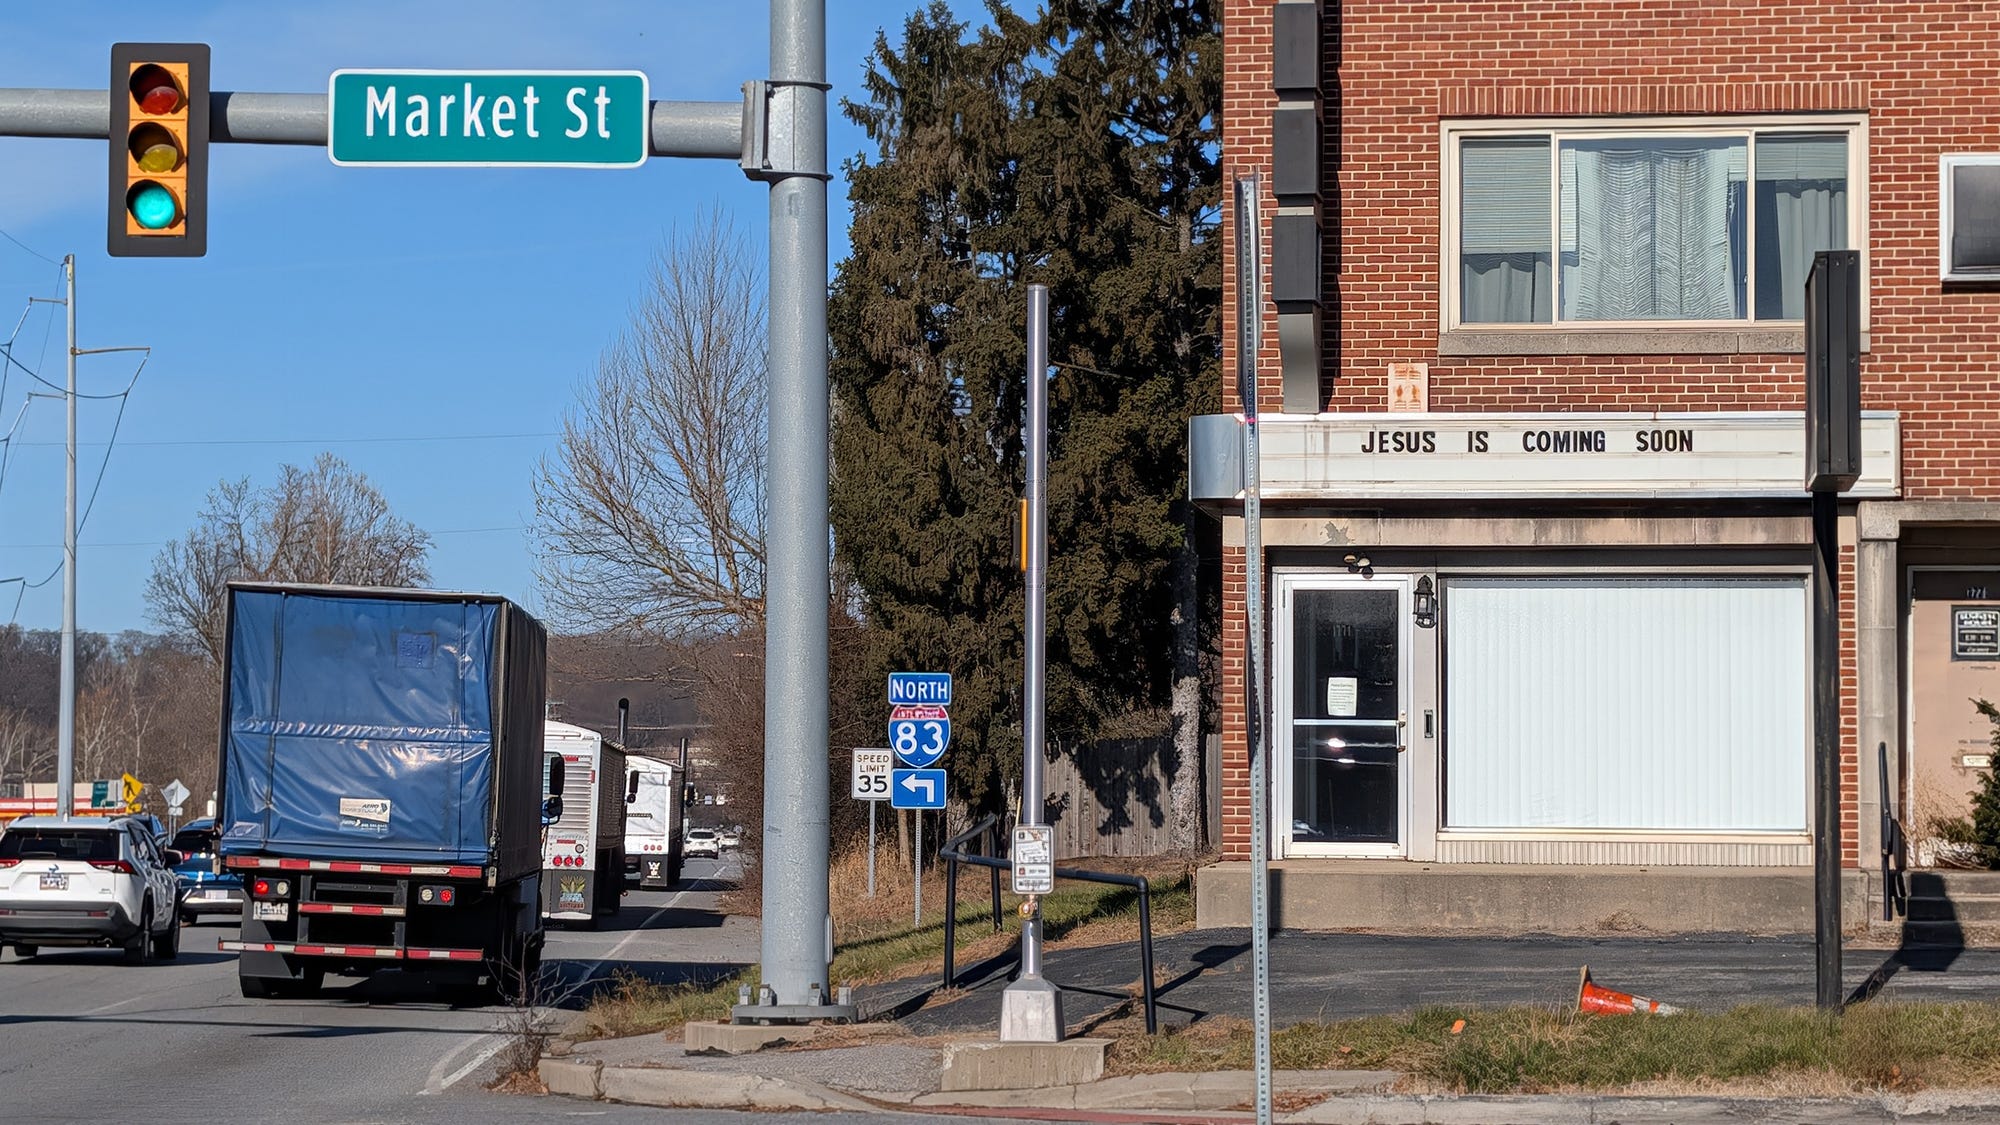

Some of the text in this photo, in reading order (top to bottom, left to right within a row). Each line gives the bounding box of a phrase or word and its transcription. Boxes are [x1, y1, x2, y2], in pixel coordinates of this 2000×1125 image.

[366, 82, 611, 139] Market St
[1361, 429, 1693, 454] JESUS IS COMING SOON
[892, 679, 948, 699] NORTH
[895, 720, 943, 755] 83
[856, 754, 890, 763] SPEED
[859, 764, 886, 773] LIMIT
[858, 775, 888, 793] 35
